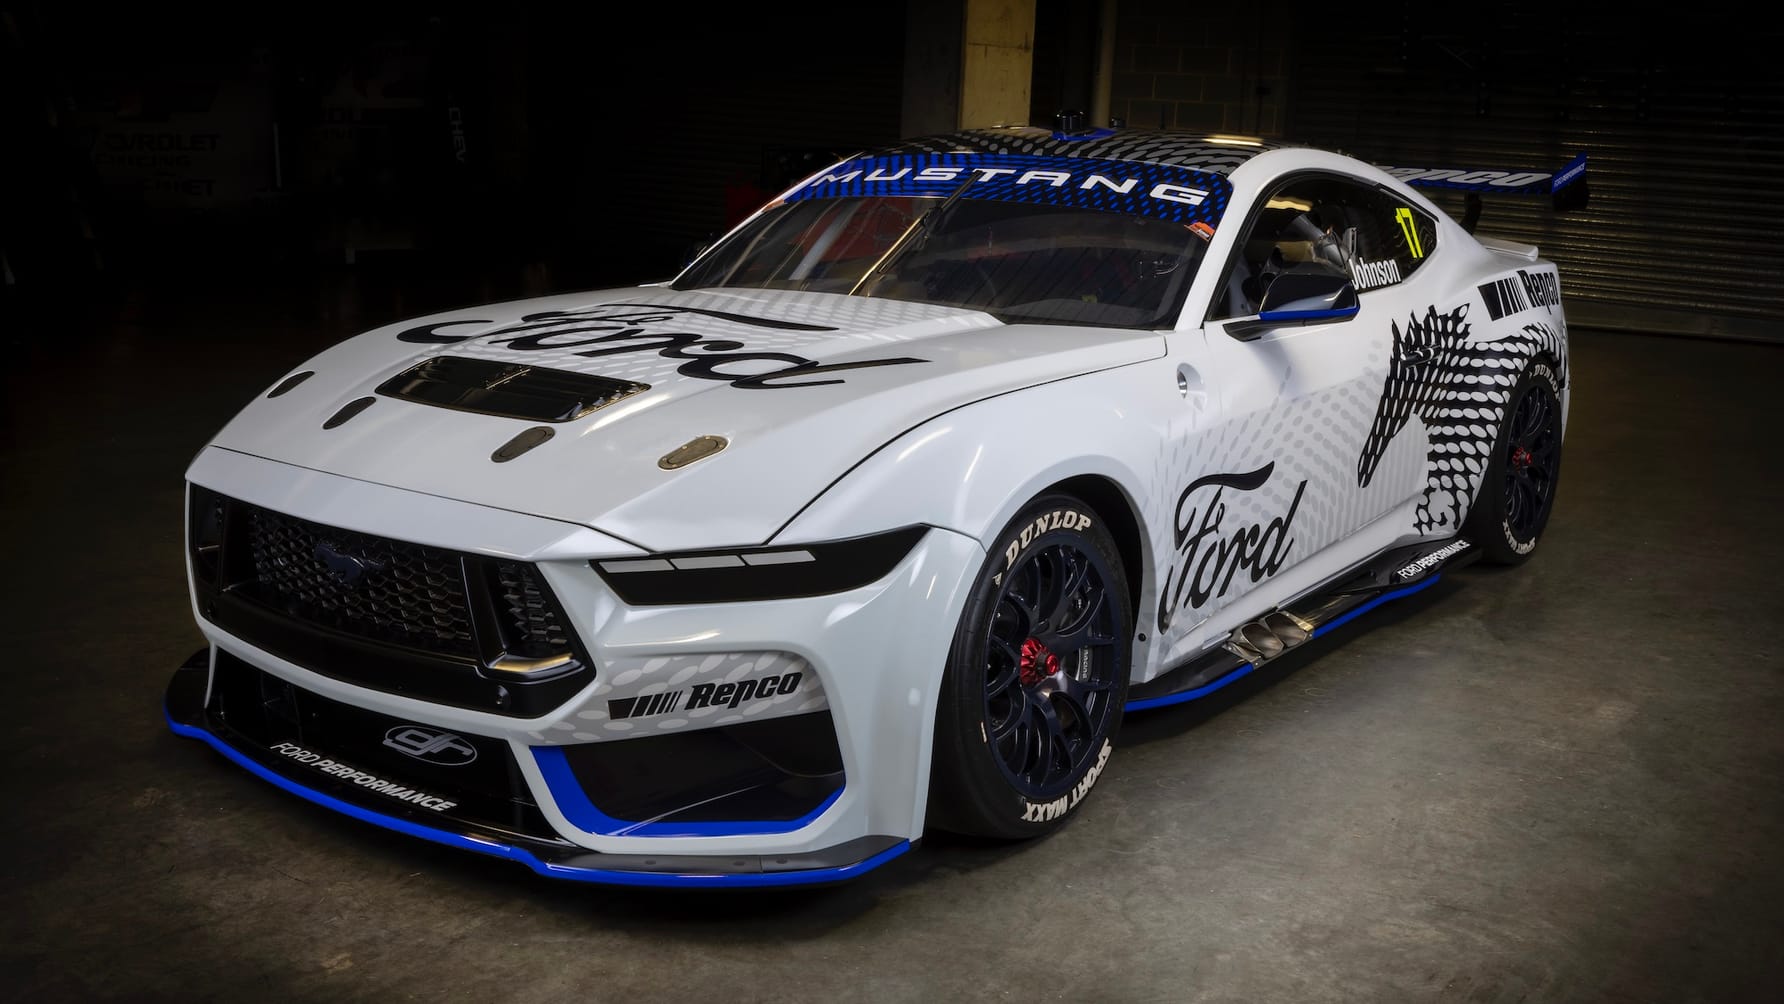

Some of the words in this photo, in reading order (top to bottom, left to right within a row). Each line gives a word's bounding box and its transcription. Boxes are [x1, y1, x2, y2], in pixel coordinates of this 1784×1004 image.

[811, 167, 1211, 206] MUSTANG
[1376, 165, 1552, 187] epco
[1395, 208, 1423, 258] 17
[1349, 257, 1401, 290] Johnson
[1516, 270, 1559, 315] Repco
[397, 303, 931, 389] Ford
[1006, 510, 1092, 571] DUNLOP
[1158, 461, 1307, 635] Ford
[684, 672, 803, 710] Repco
[270, 742, 321, 764] FORD
[310, 759, 457, 811] PERFORMANCE
[1069, 736, 1113, 810] SPORT
[1020, 794, 1068, 823] MAXX
